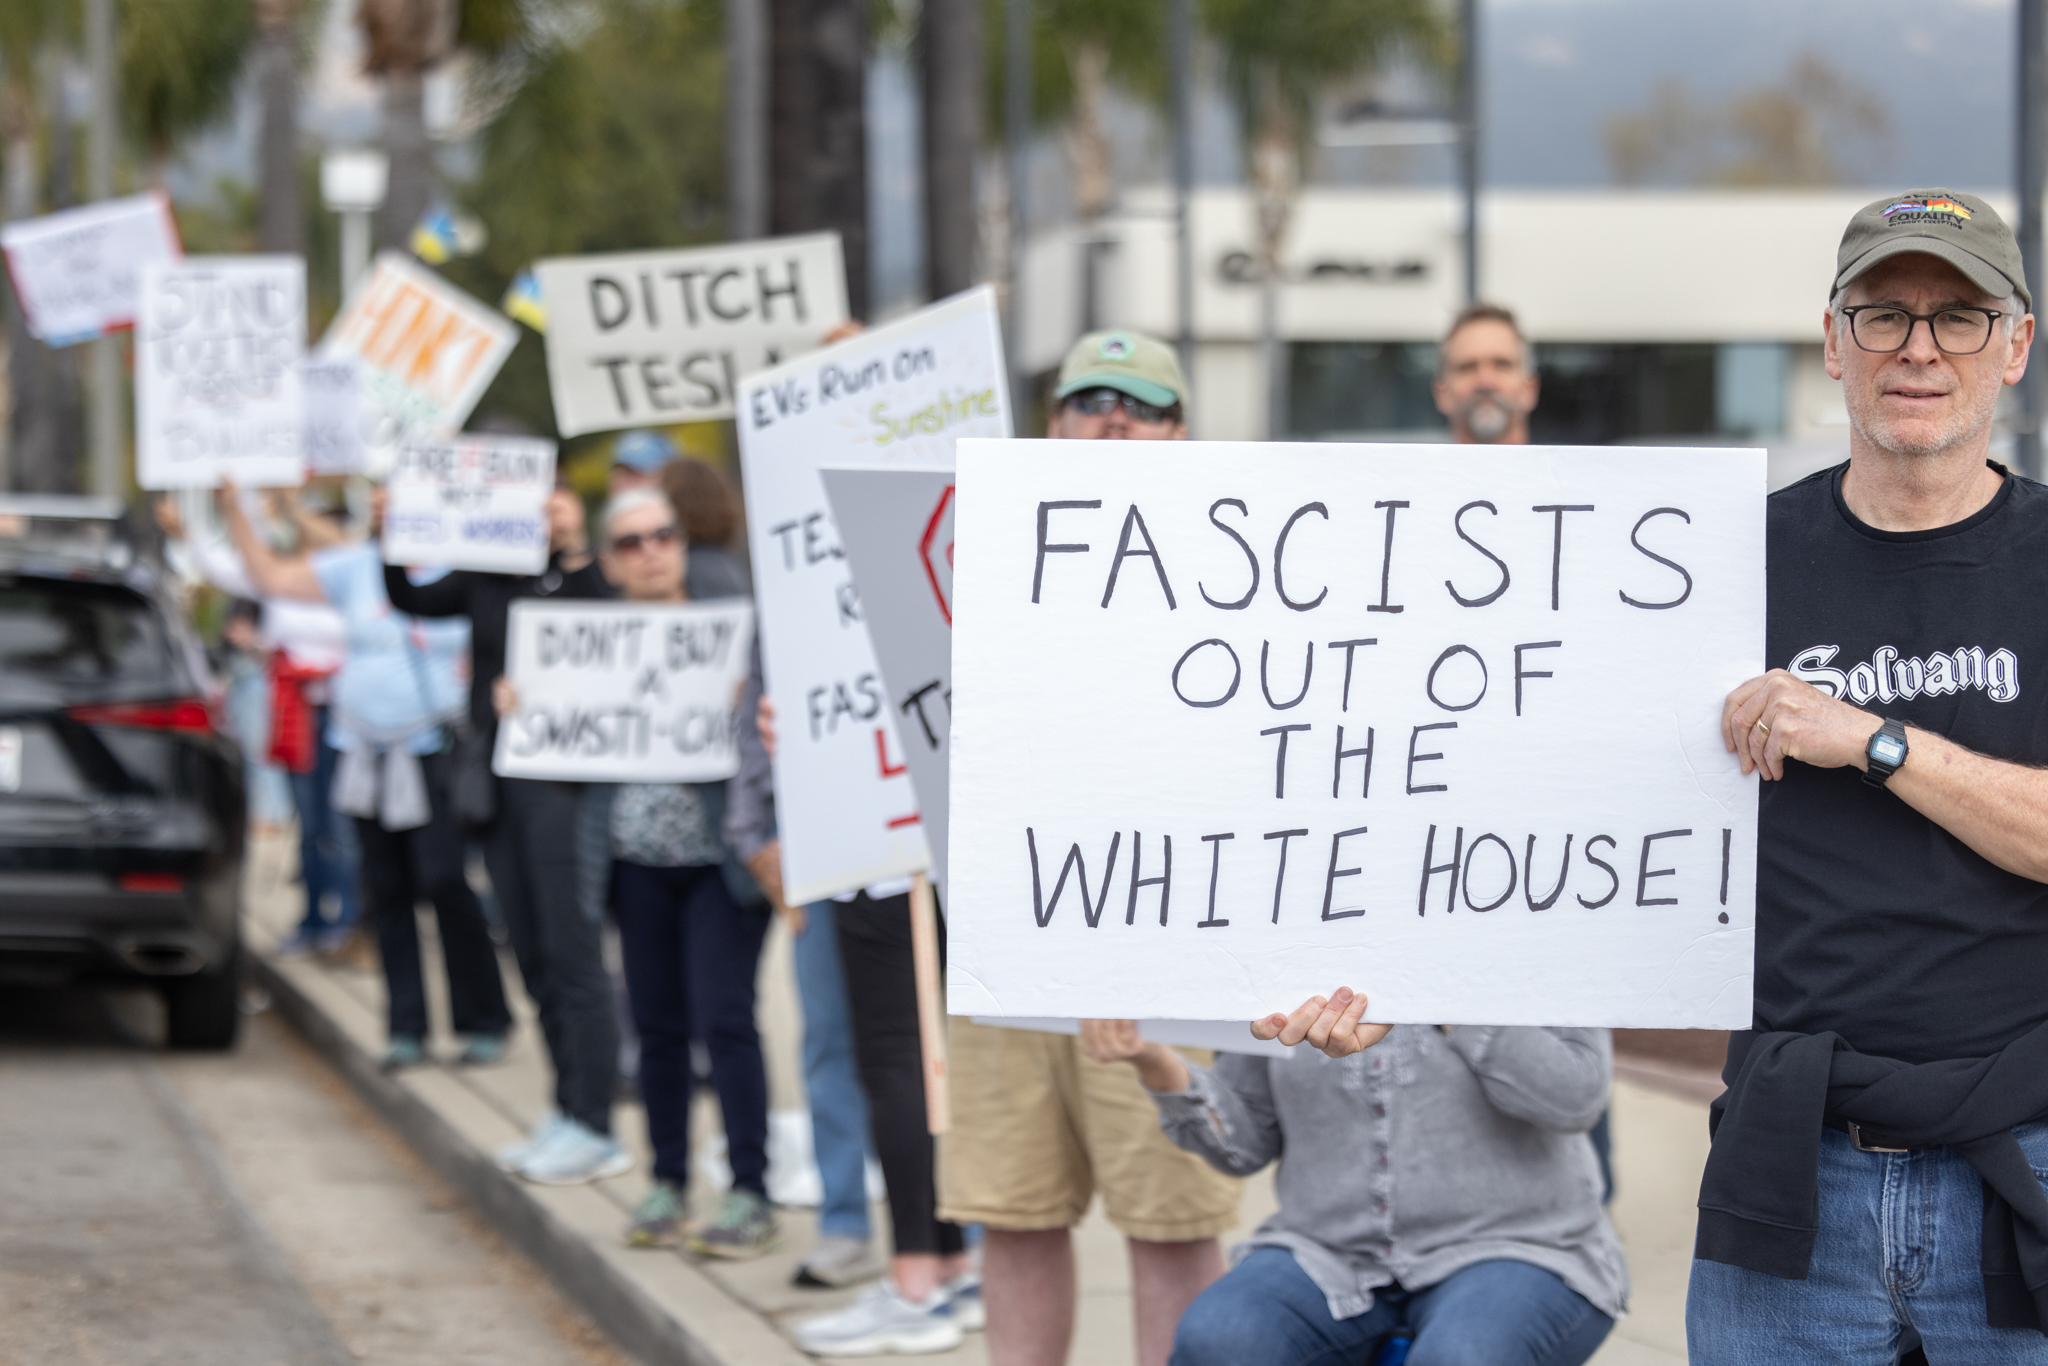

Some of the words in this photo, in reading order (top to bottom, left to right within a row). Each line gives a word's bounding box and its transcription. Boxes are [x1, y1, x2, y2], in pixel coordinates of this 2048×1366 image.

[1888, 212, 1965, 225] EQUALITY
[1923, 220, 1963, 231] EXCEPTION
[586, 258, 810, 333] DITCH
[587, 348, 782, 417] TESL
[750, 380, 810, 431] EVs
[816, 355, 885, 403] Run
[1031, 497, 1693, 613] FASCISTS
[535, 615, 648, 672] DON'T
[664, 613, 738, 676] BUY
[1172, 638, 1377, 712] OUT
[1426, 639, 1562, 717] OF
[1788, 645, 2020, 705] Solvang
[1260, 722, 1458, 799] THE
[1026, 827, 1368, 929] WHITE
[1418, 824, 1732, 926] HOUSE!
